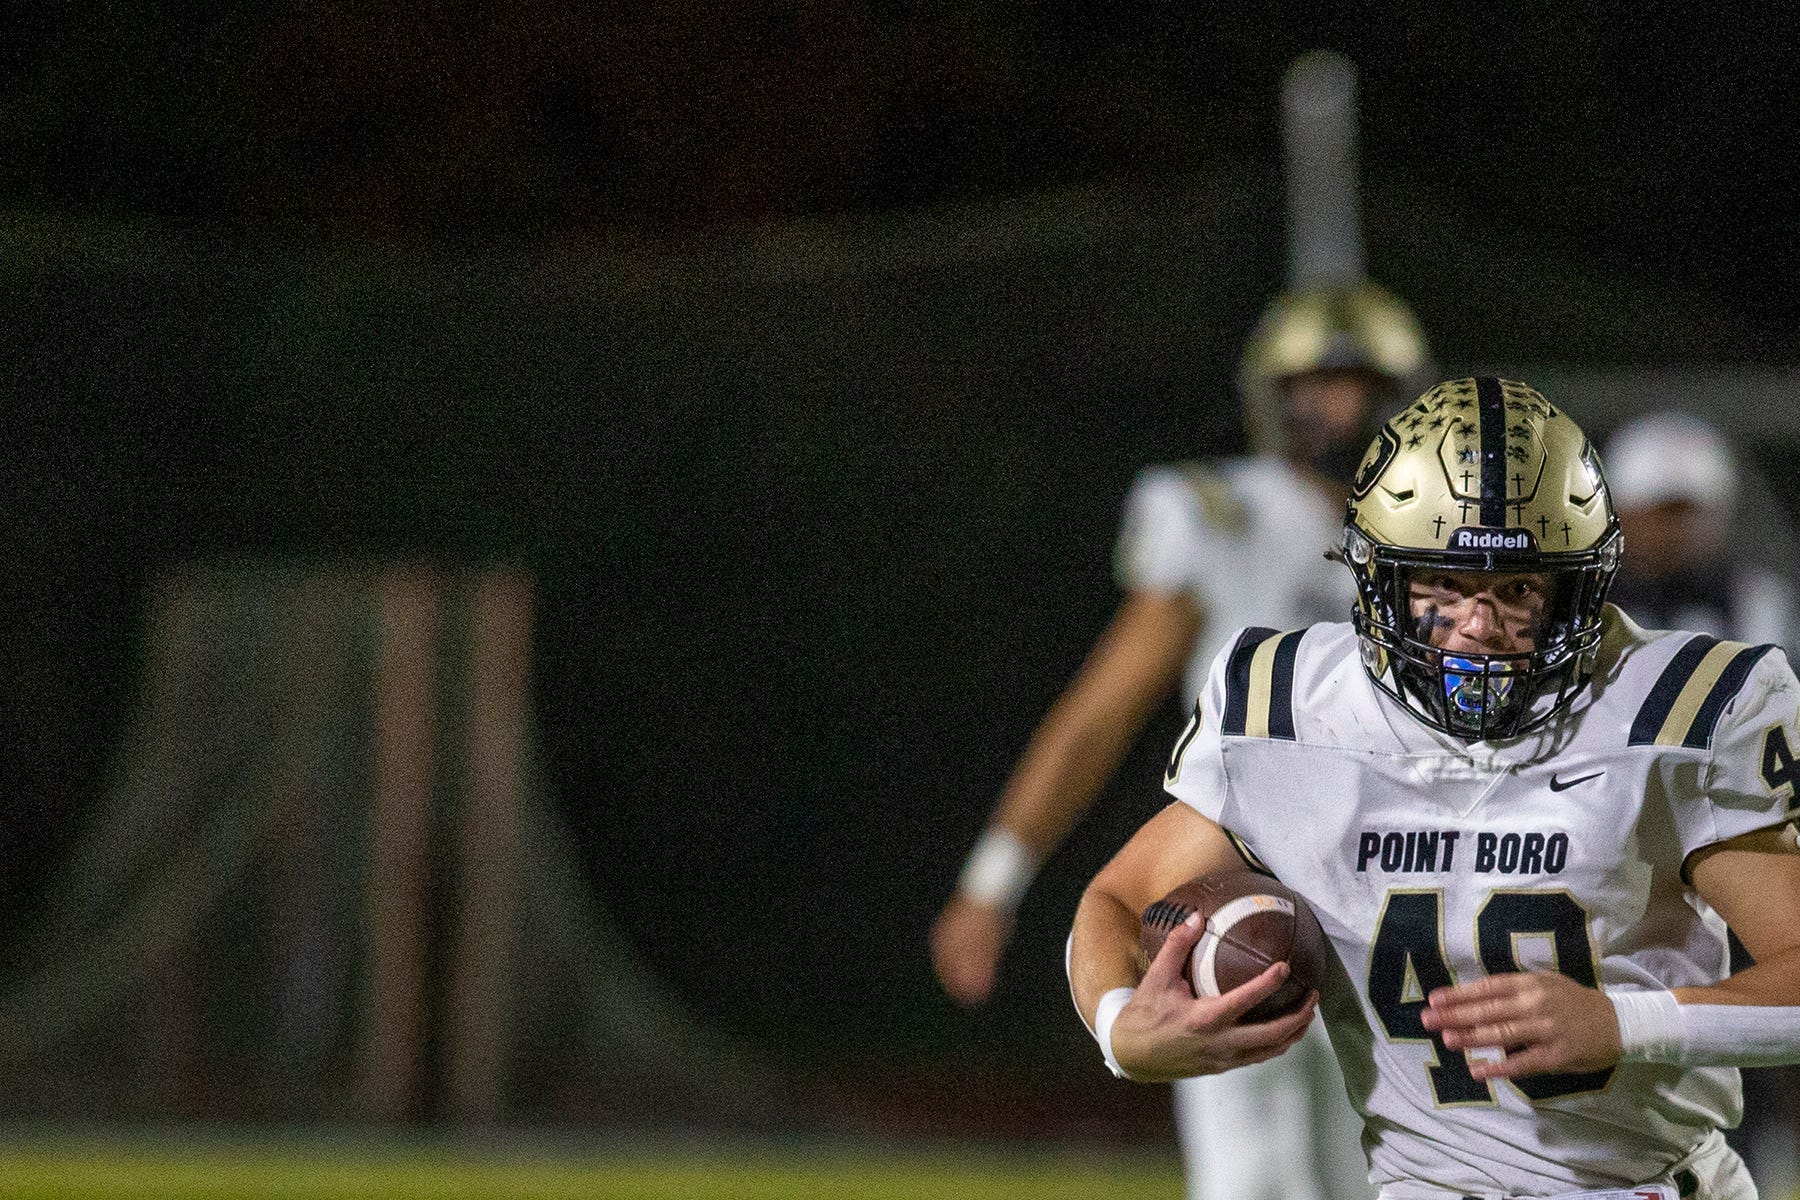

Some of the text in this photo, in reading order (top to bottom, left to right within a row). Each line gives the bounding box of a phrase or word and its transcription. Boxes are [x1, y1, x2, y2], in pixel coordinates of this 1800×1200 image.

[1458, 531, 1528, 548] Riddell
[1356, 831, 1569, 874] POINT BORO
